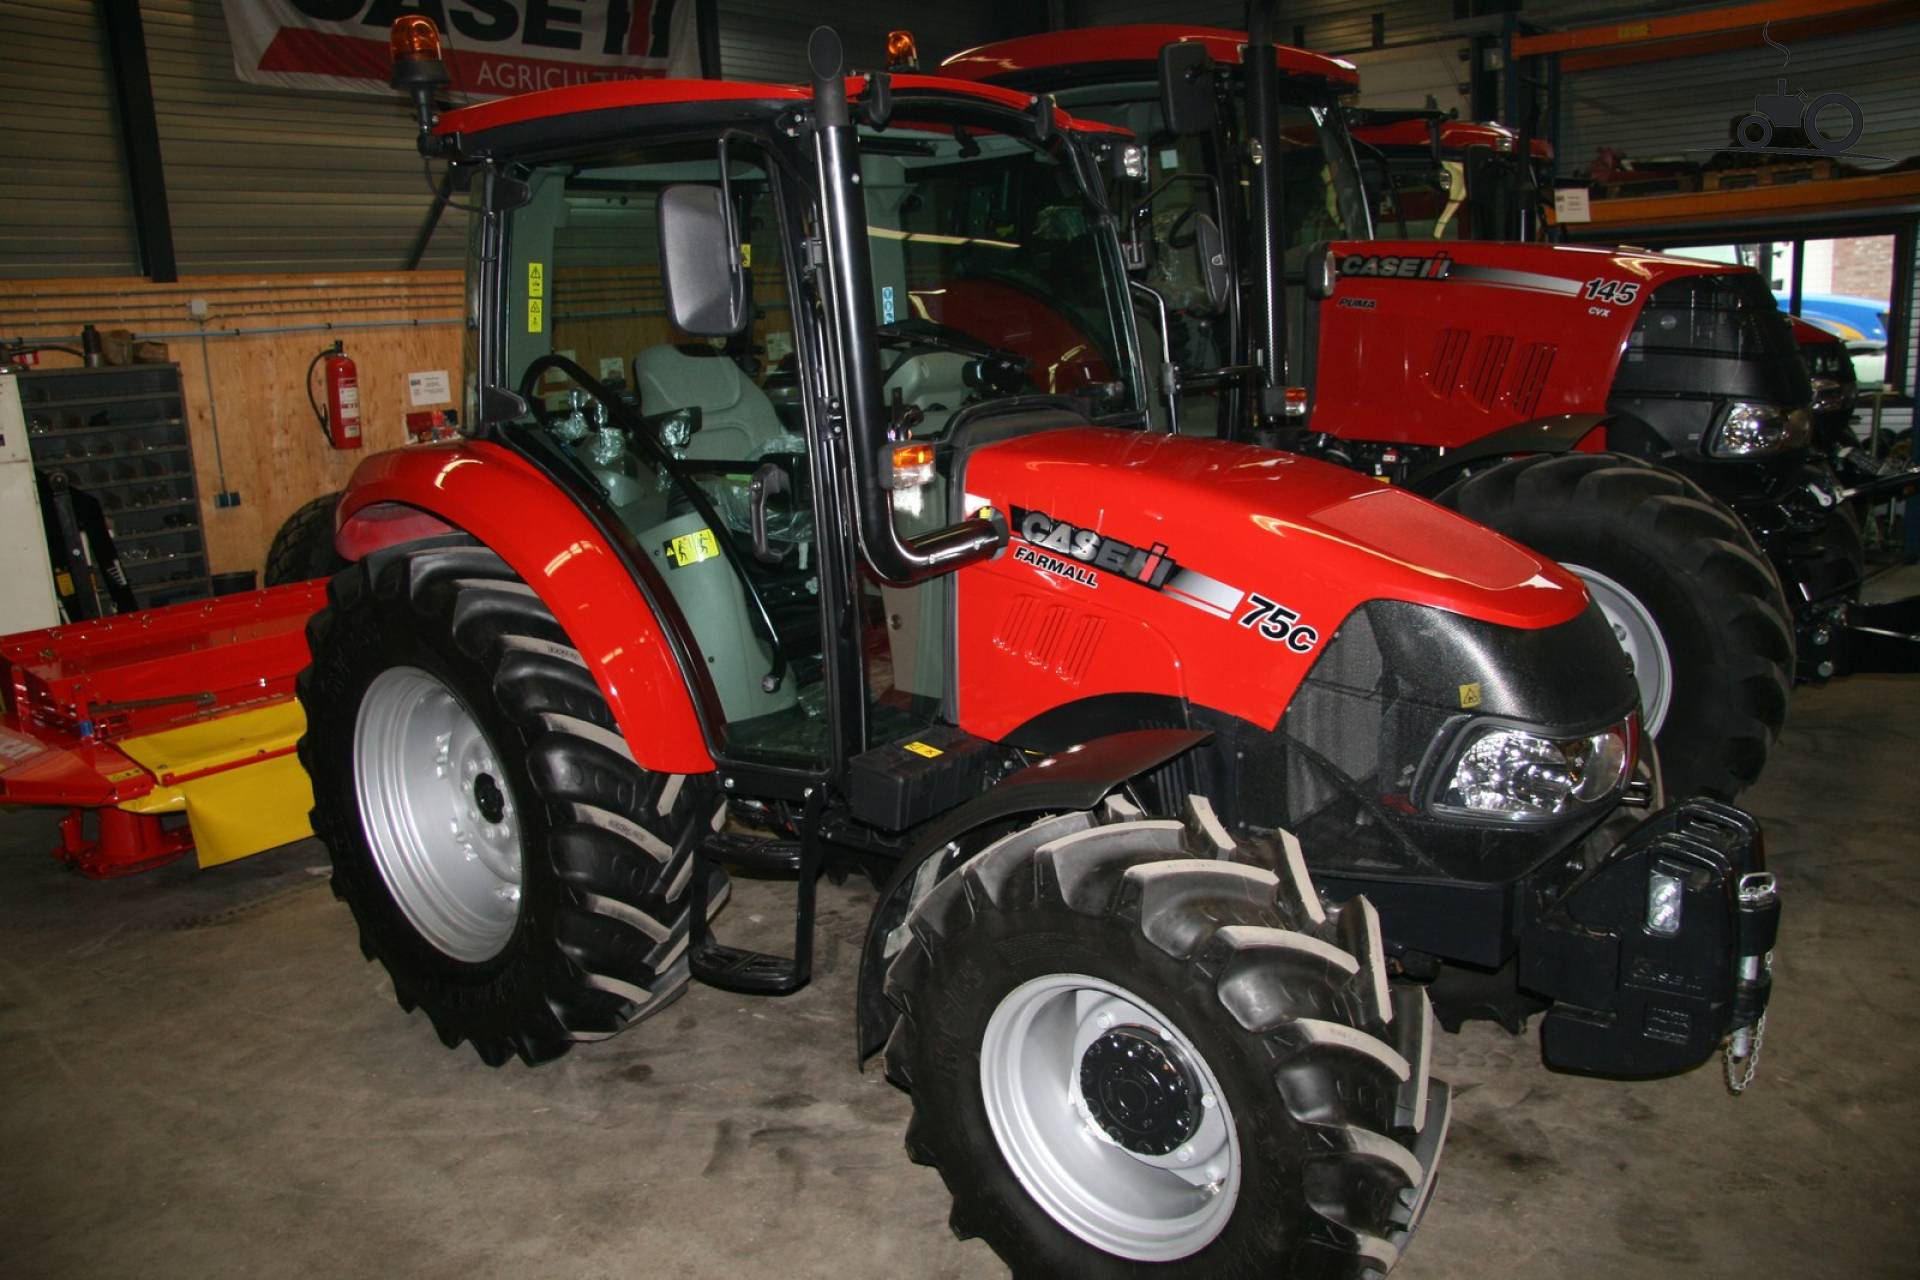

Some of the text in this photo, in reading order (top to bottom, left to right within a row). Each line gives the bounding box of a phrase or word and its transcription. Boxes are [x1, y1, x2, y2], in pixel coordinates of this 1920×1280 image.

[289, 0, 582, 50] SE
[477, 60, 656, 90] AGRICU
[1341, 254, 1420, 278] CASE
[1585, 278, 1641, 306] 145
[1021, 510, 1132, 572] CASE
[1014, 547, 1099, 588] FARMALL
[1238, 592, 1319, 655] 75C
